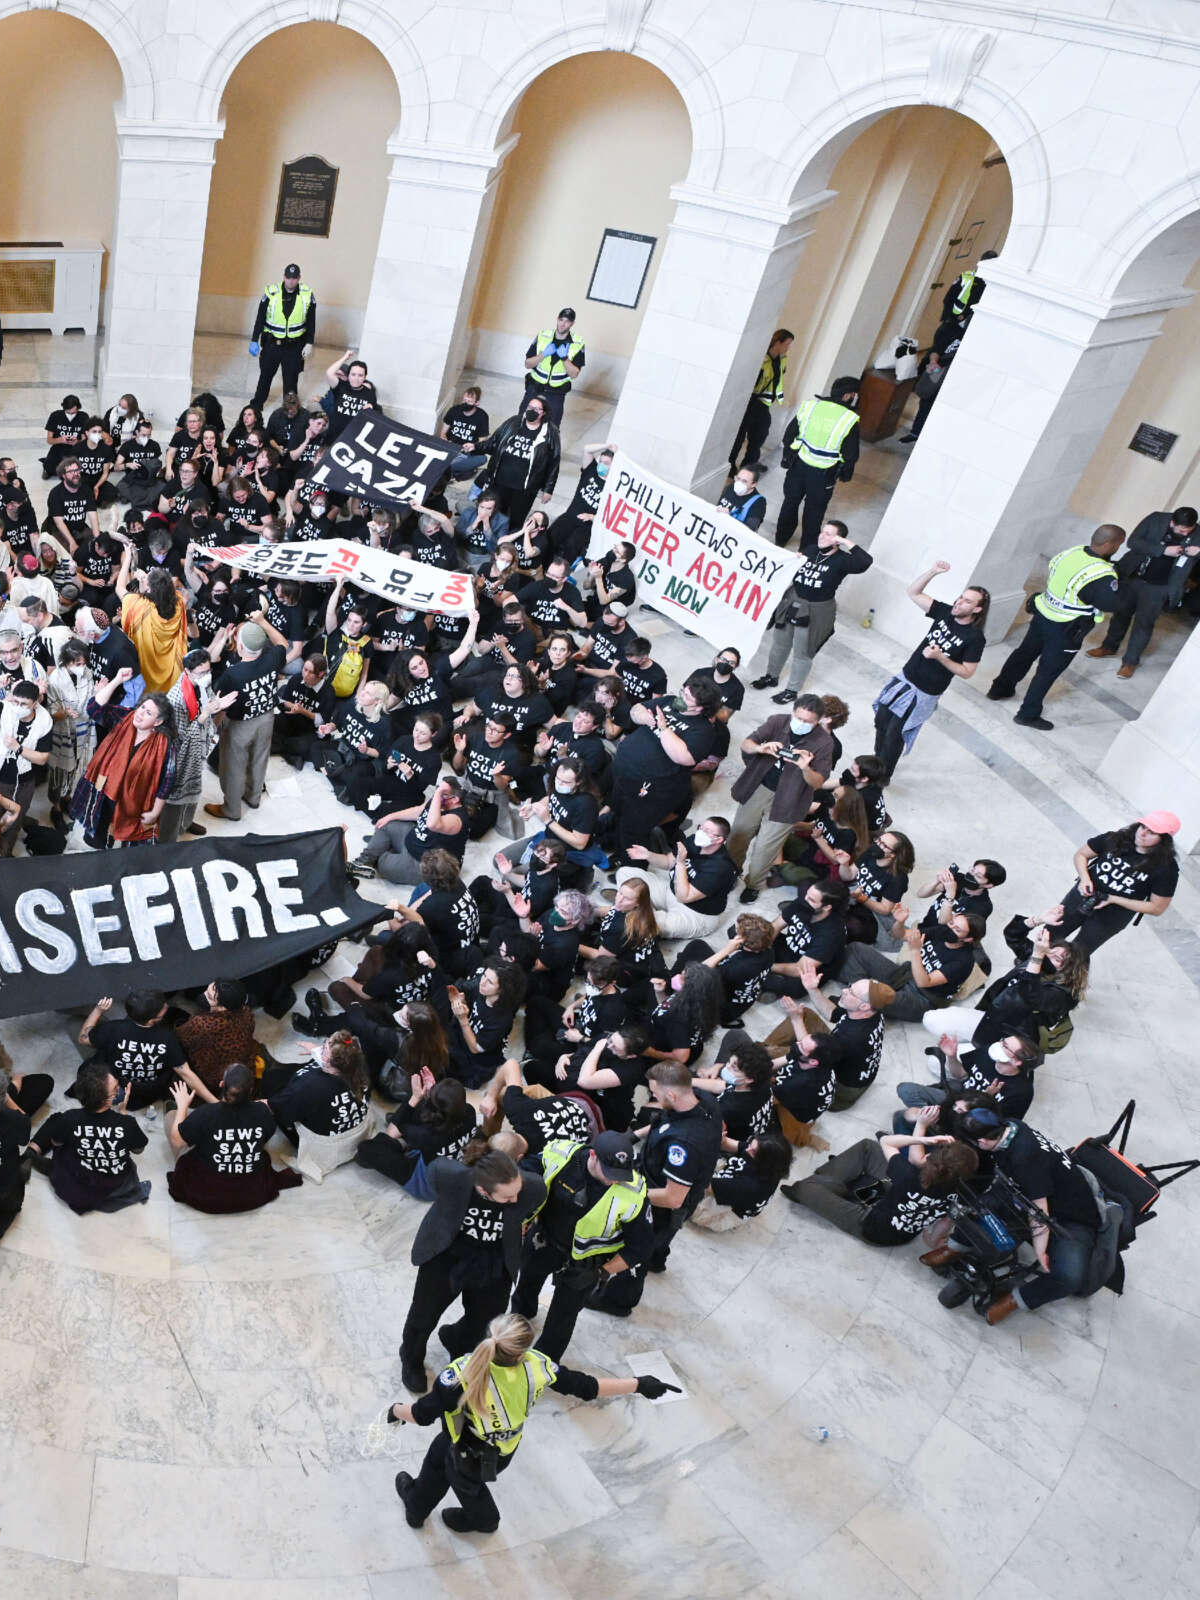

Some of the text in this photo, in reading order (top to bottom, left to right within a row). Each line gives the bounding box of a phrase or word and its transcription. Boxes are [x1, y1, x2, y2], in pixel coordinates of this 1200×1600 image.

[342, 394, 356, 402] NOT
[453, 421, 467, 430] NOT
[454, 427, 472, 435] OUR
[515, 435, 530, 443] NOT
[355, 421, 448, 477] LET
[505, 446, 532, 459] NAM
[331, 442, 426, 505] GAZA
[616, 471, 783, 582] PHILLY JEWS SAY
[601, 493, 771, 622] NEVER AGAIN
[817, 564, 828, 572] IN
[638, 559, 709, 614] IS NOW
[539, 607, 559, 615] OUR
[434, 616, 456, 625] OUR
[383, 630, 401, 639] NOT
[596, 632, 610, 647] NOT
[933, 630, 952, 650] OUR
[938, 620, 964, 646] NOT IN
[243, 671, 276, 692] JEWS
[623, 670, 650, 688] NOT IN
[249, 682, 273, 699] SAY
[292, 690, 309, 702] NOT
[407, 686, 430, 699] OUR
[491, 703, 513, 712] NOT
[346, 713, 374, 740] NOT IN
[346, 725, 366, 741] OUR
[470, 750, 491, 765] NOT
[1106, 853, 1130, 870] NOT
[1099, 863, 1137, 887] OUR
[117, 1039, 167, 1054] JEWS
[122, 1052, 159, 1064] SAY
[114, 1060, 164, 1071] CEASE
[121, 1069, 155, 1078] FIRE
[971, 1064, 990, 1086] NOT
[73, 1125, 124, 1139] JEWS
[213, 1127, 263, 1141] JEWS
[80, 1138, 118, 1149] SAY
[219, 1141, 257, 1154] SAY
[77, 1148, 126, 1159] CEASE
[213, 1152, 260, 1163] CEASE
[218, 1163, 253, 1173] FIRE
[463, 1217, 503, 1231] OUR
